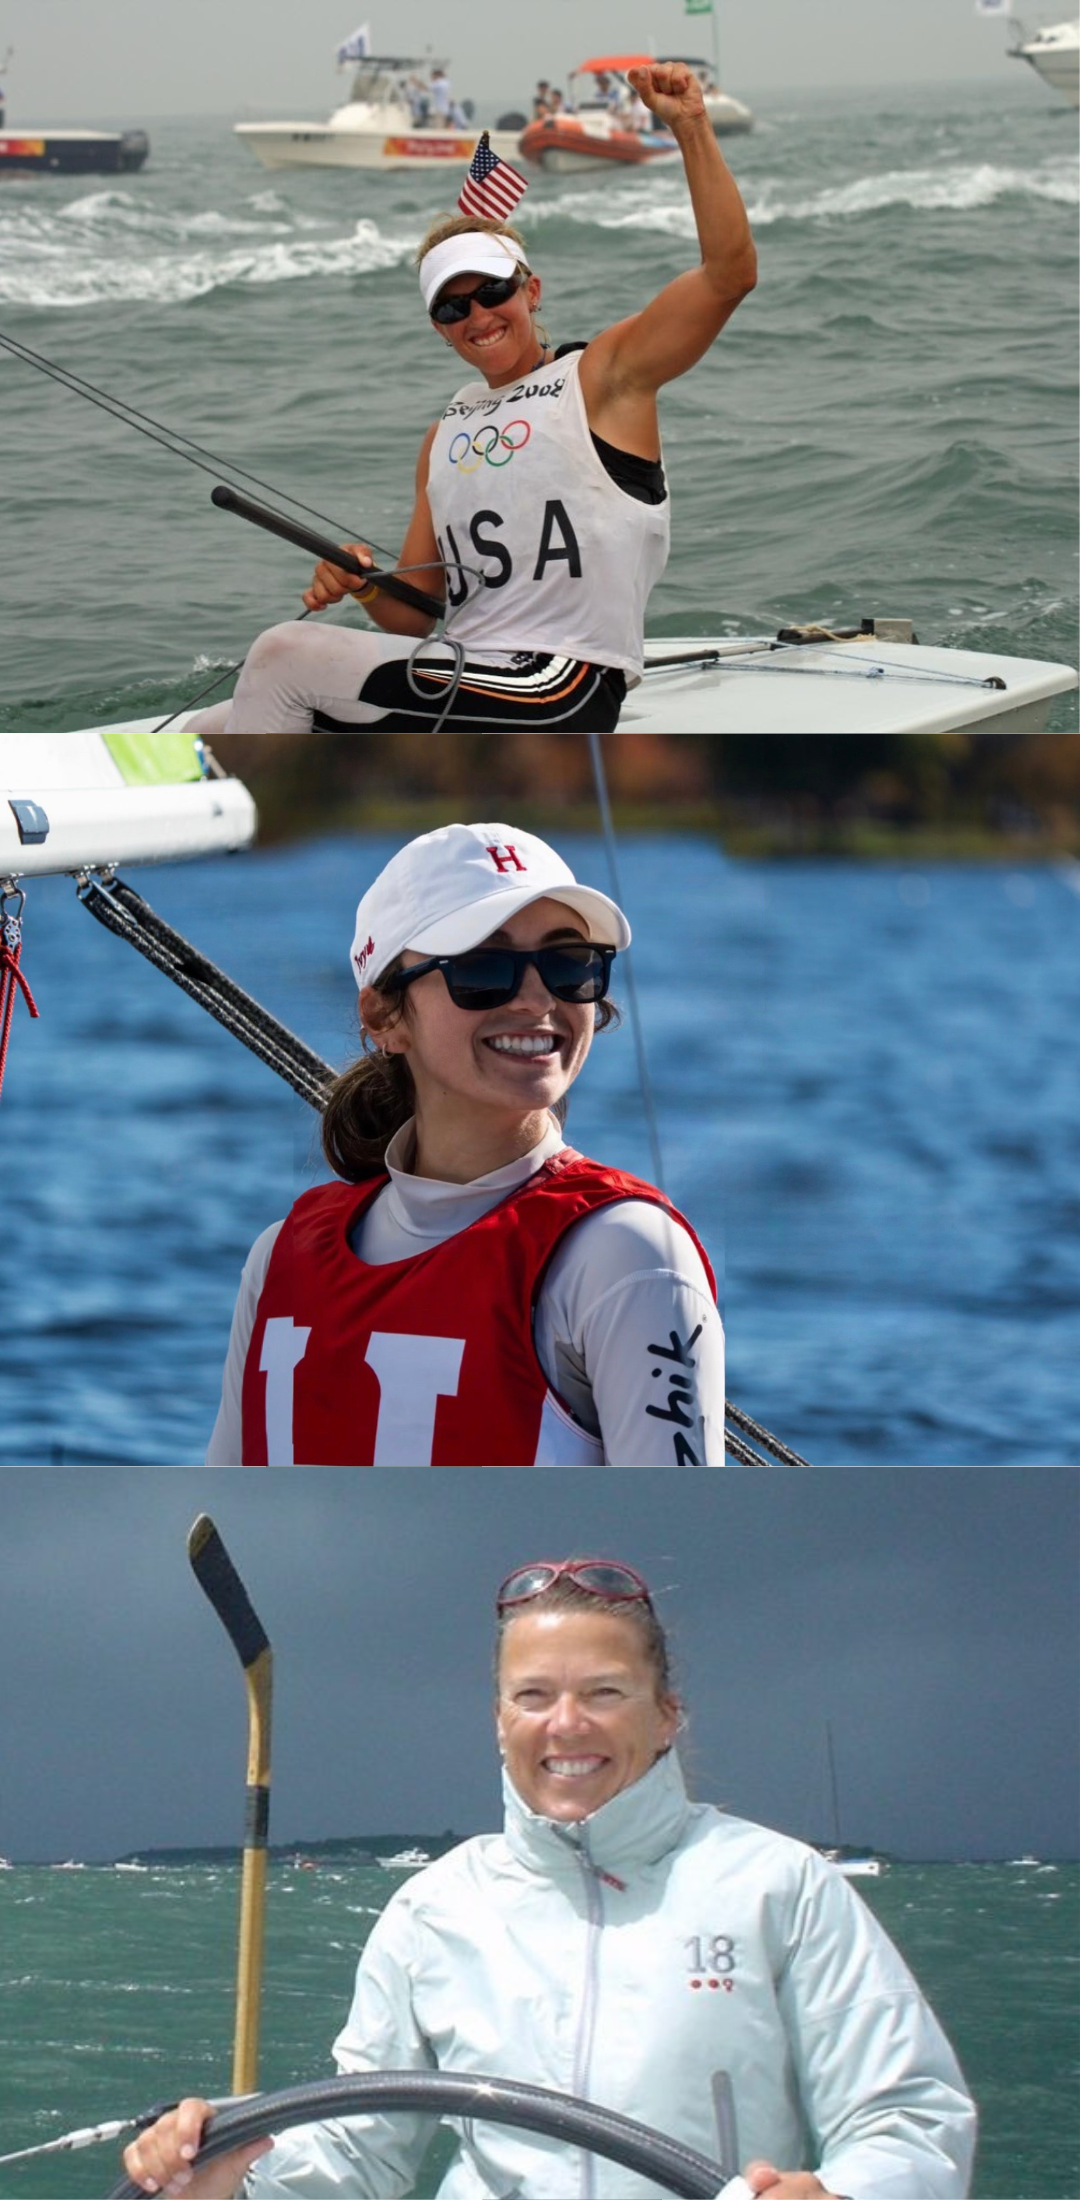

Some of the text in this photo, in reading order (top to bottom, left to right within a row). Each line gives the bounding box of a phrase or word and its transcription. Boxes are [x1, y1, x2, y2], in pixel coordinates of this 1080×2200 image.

[442, 378, 566, 421] Beijing 2008
[437, 499, 582, 607] USA
[486, 844, 528, 873] H
[645, 1323, 708, 1467] zhik
[683, 1933, 737, 1974] 18
